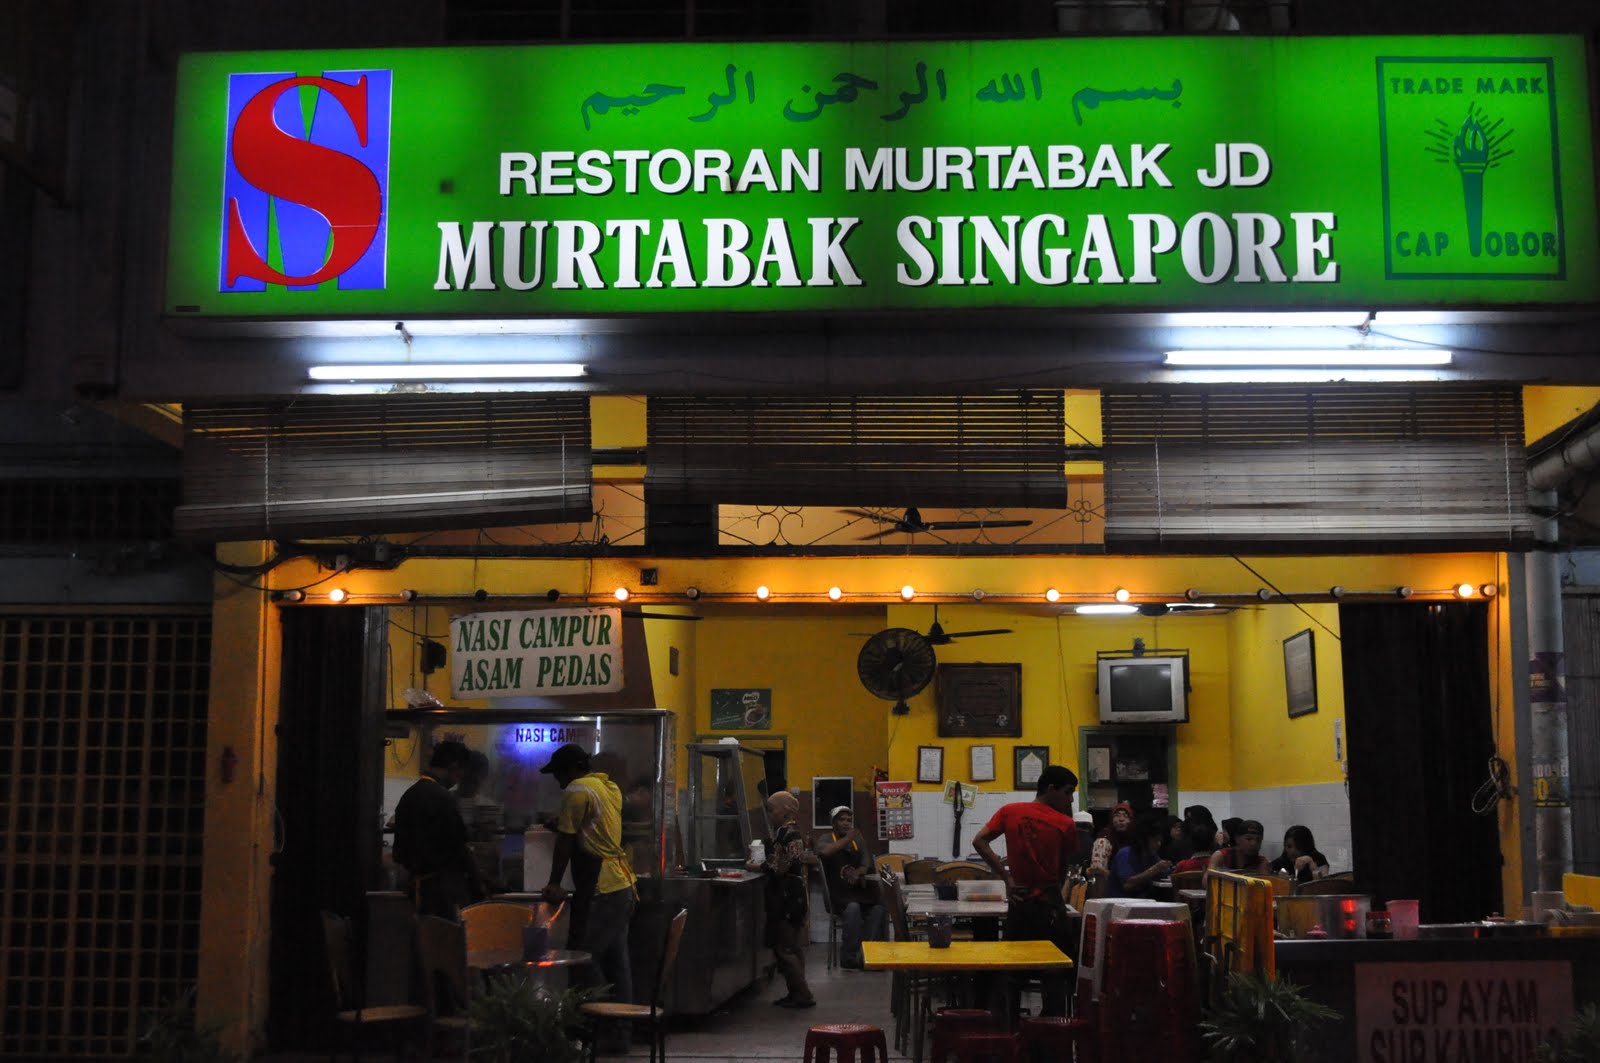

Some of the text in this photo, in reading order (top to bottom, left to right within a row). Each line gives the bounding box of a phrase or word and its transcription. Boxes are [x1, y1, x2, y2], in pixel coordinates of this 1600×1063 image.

[976, 67, 1042, 103] الله
[1072, 78, 1183, 126] بسم
[1390, 77, 1544, 95] TRADE MARK
[499, 142, 1270, 195] RESTORAN MURTABAK JD
[433, 211, 1337, 291] MURTABAK SINGAPORE
[1395, 231, 1557, 257] CAP OBOR
[456, 613, 612, 652] NASI CAMPUR
[458, 652, 612, 691] ASAM PEDAS
[515, 728, 544, 743] NASI
[1391, 979, 1540, 1025] SUP AYAM
[1369, 1028, 1426, 1063] SUP
